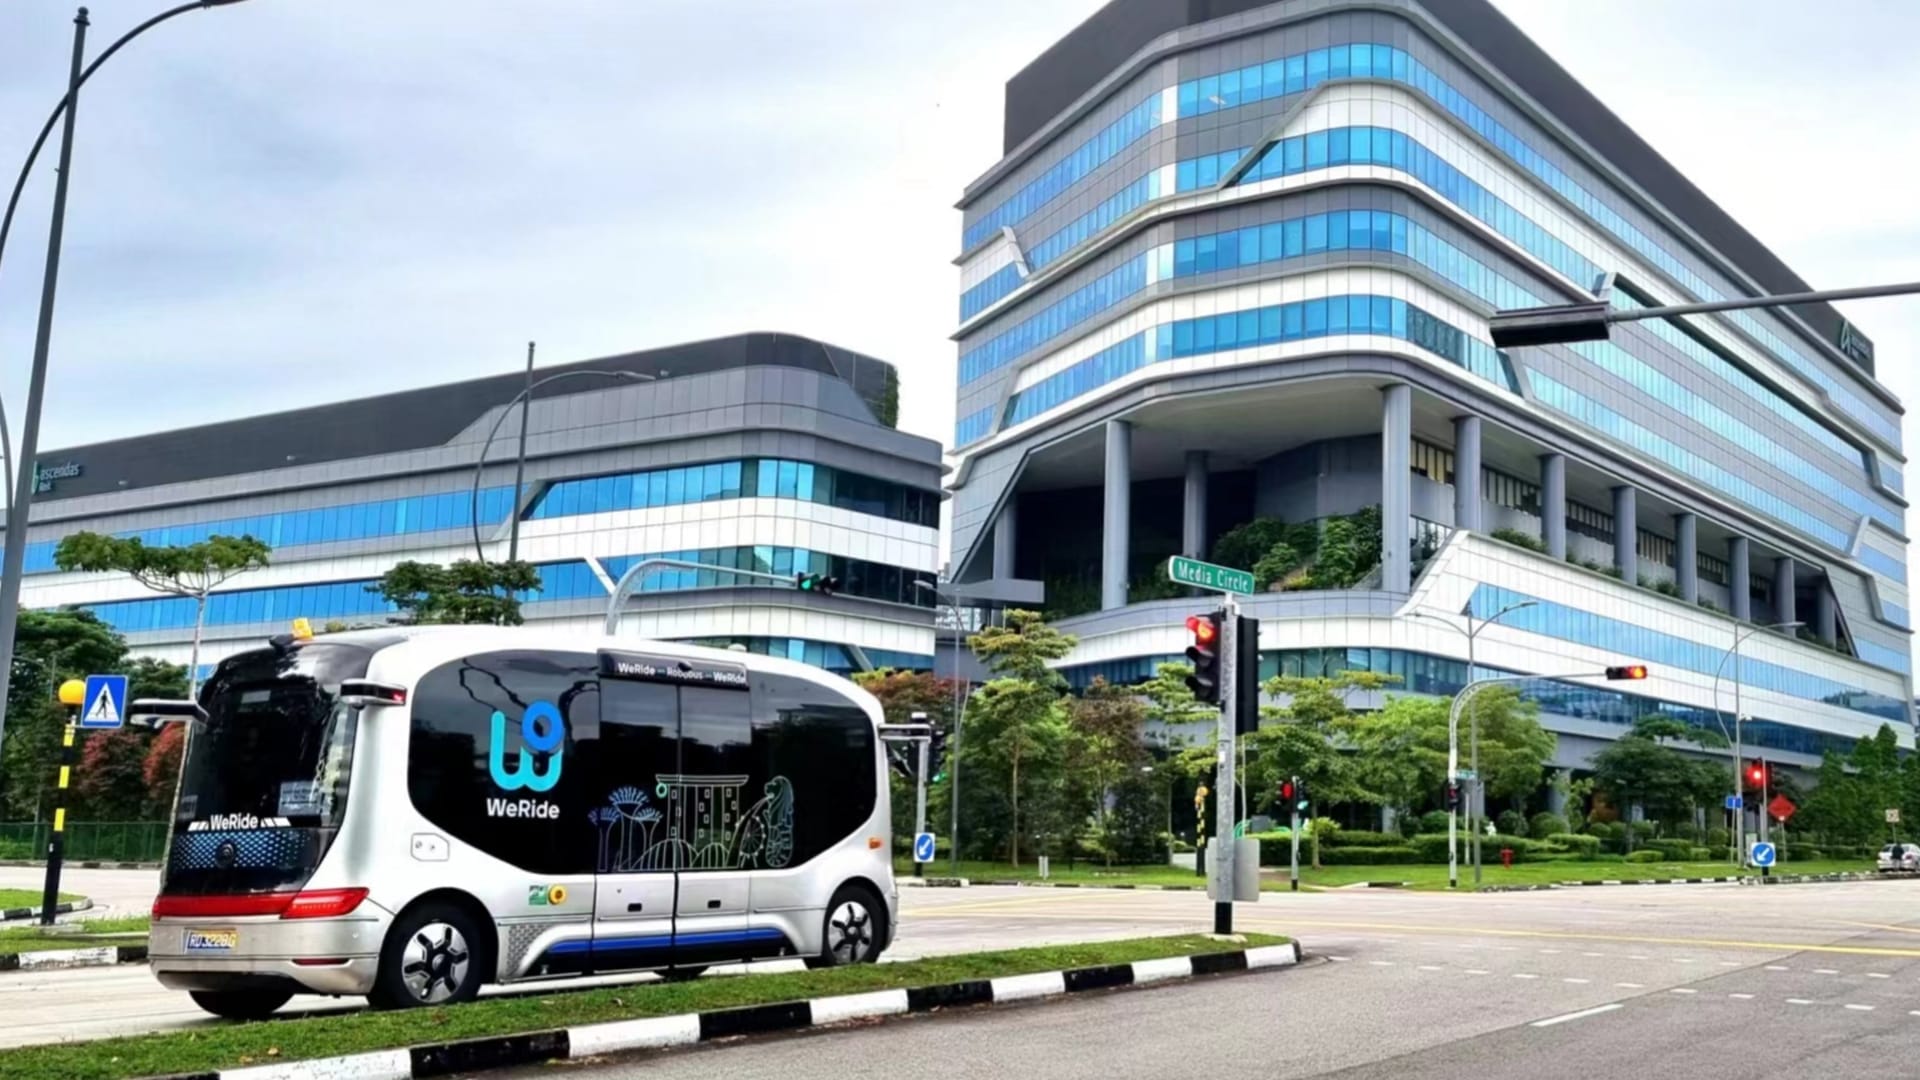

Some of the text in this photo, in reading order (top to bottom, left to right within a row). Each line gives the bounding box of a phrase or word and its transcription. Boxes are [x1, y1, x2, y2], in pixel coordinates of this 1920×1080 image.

[1178, 561, 1249, 592] Media Circle
[618, 662, 656, 676] WeRide
[486, 798, 560, 819] WeRide
[210, 812, 259, 831] WeRide
